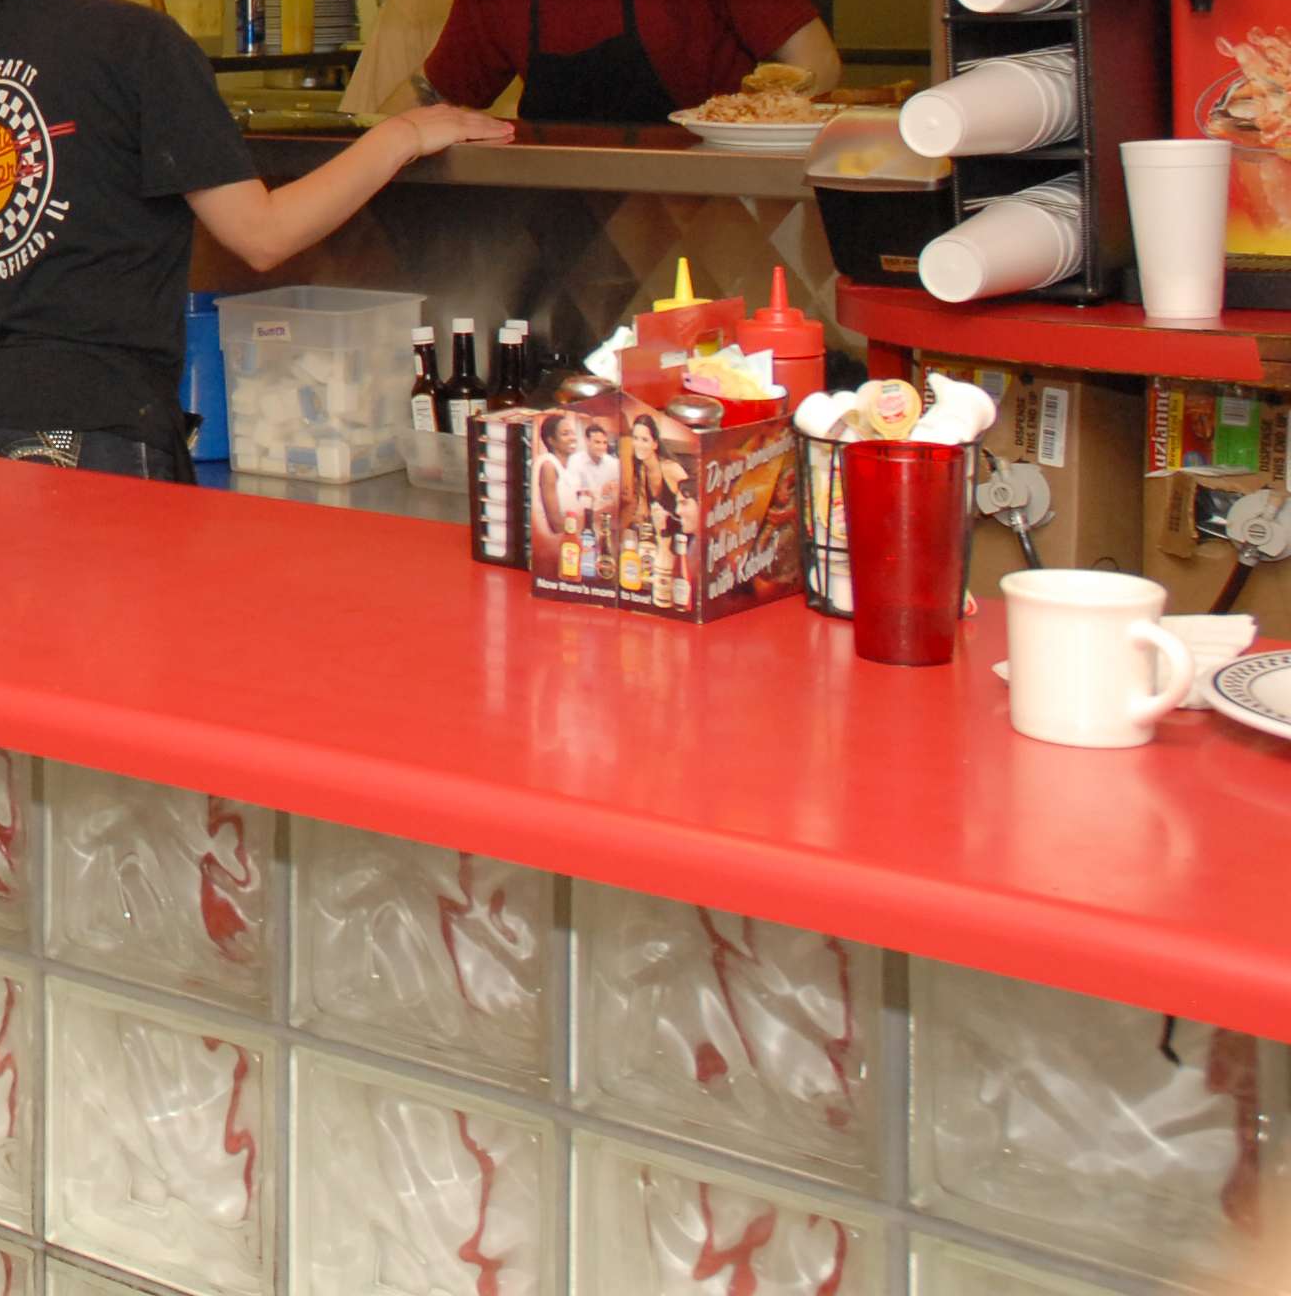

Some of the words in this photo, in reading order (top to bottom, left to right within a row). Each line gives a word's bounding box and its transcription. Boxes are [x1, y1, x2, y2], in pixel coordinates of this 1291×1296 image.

[20, 65, 38, 87] IT
[44, 199, 70, 221] IL
[1015, 396, 1026, 447] DISPENSE
[1027, 406, 1038, 431] END
[1152, 388, 1169, 469] uzianne
[1026, 431, 1038, 455] THIS
[1274, 432, 1286, 454] END
[706, 460, 723, 494] Do
[722, 459, 745, 494] you
[1273, 456, 1286, 482] THIS
[536, 578, 559, 590] Now
[558, 580, 591, 595] there's
[590, 586, 617, 599] more
[621, 590, 630, 602] to
[708, 564, 735, 600] with
